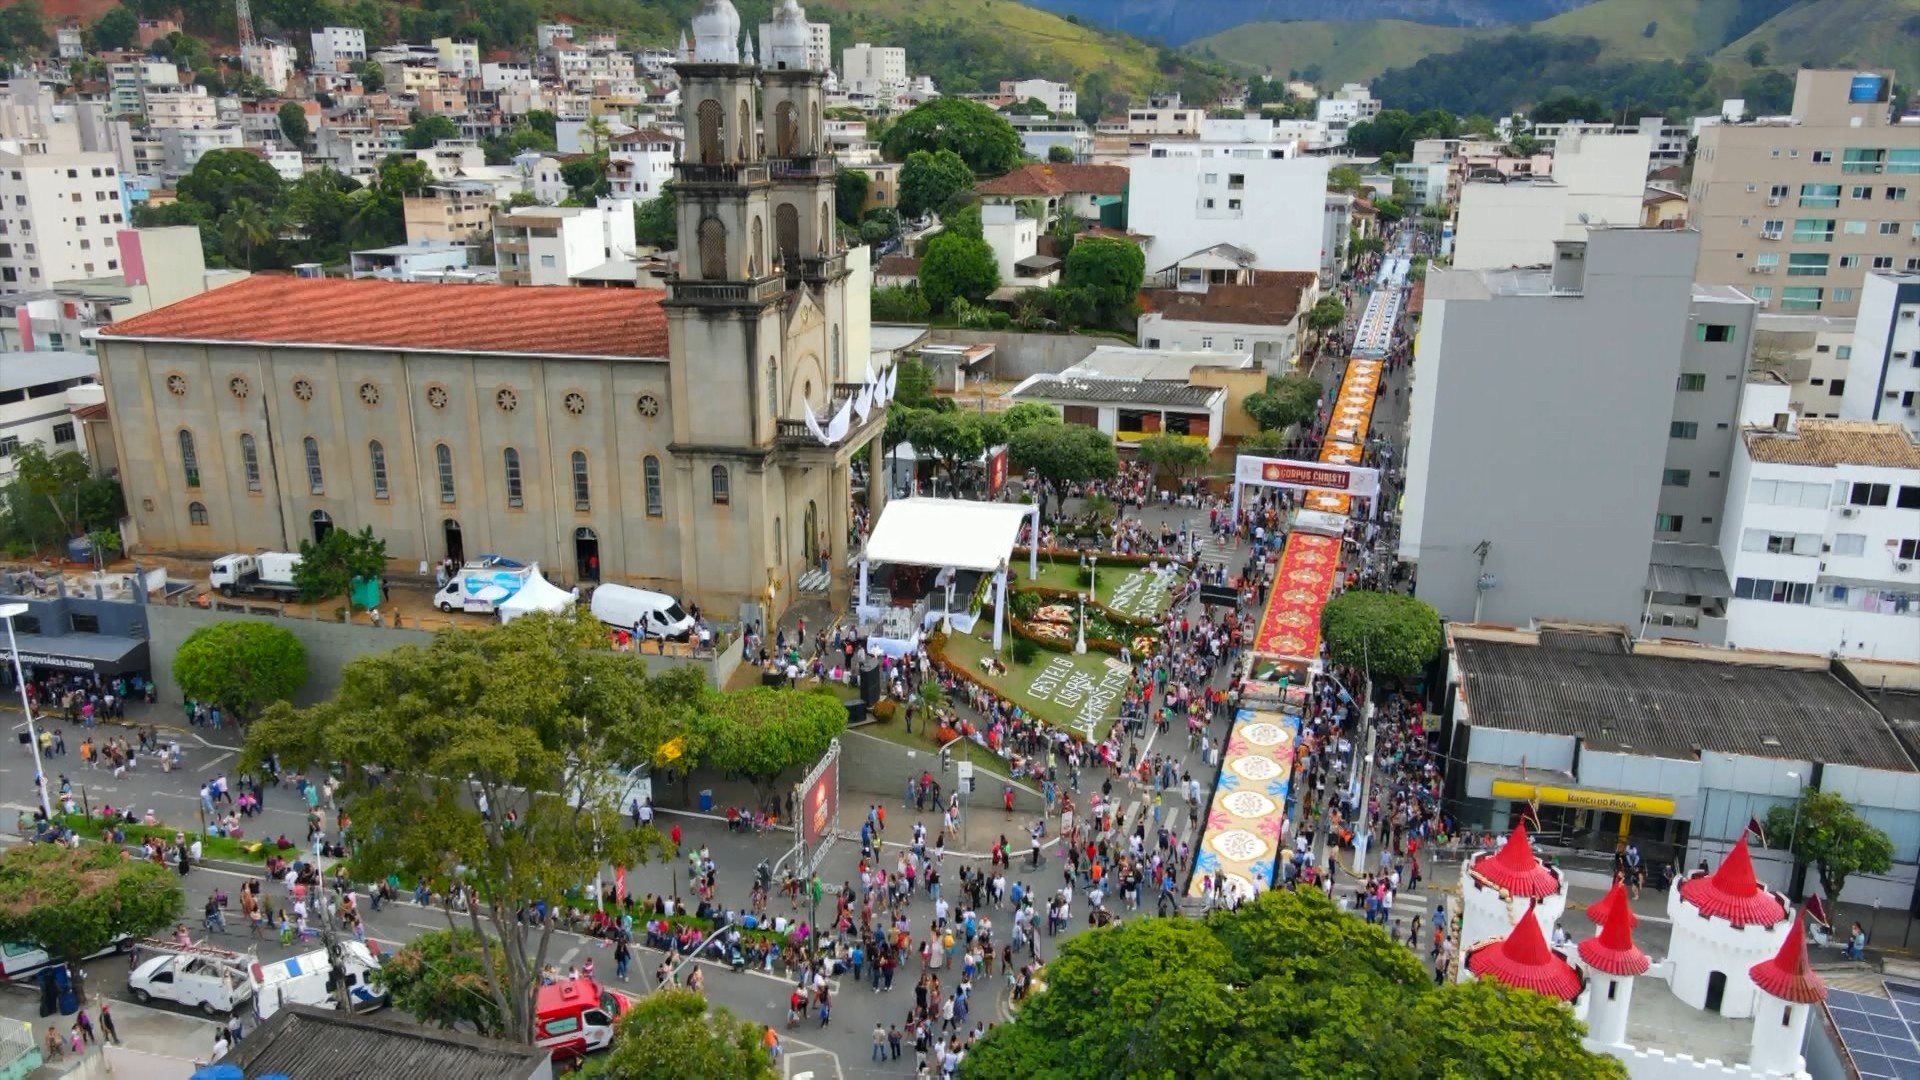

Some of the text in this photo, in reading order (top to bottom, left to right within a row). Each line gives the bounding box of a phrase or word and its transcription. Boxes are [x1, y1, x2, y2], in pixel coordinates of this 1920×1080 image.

[1280, 468, 1311, 480] CORPUS
[1313, 471, 1346, 484] CHRISTI
[65, 659, 94, 670] CENTRO
[1027, 657, 1074, 700] CASTELO
[1568, 794, 1638, 810] BANCO DO BRASIL
